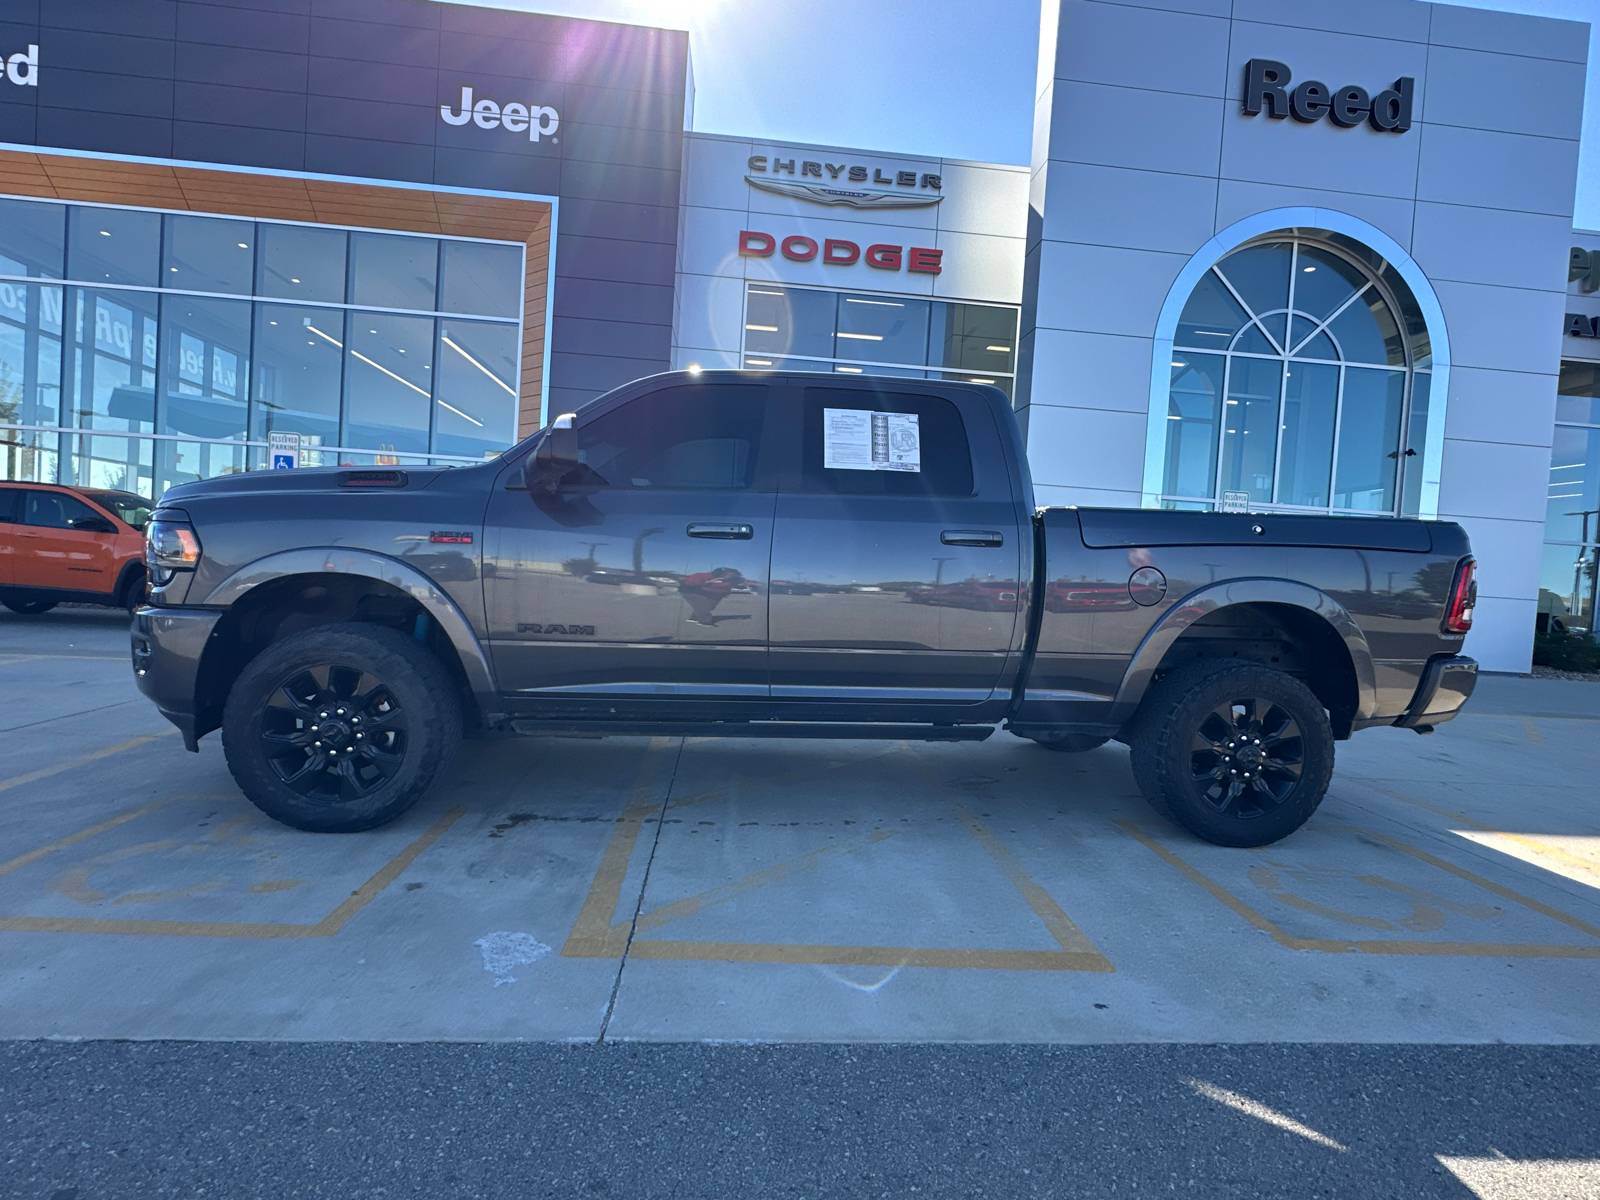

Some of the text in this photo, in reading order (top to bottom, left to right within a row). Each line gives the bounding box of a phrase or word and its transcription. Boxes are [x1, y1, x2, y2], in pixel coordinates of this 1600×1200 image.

[1242, 58, 1415, 134] Reed
[440, 86, 560, 143] Jeep
[748, 156, 942, 189] CHRYSLER
[739, 230, 943, 274] DODGE
[271, 435, 298, 443] RESERVED
[271, 443, 298, 451] PARKING
[517, 623, 595, 635] RAM
